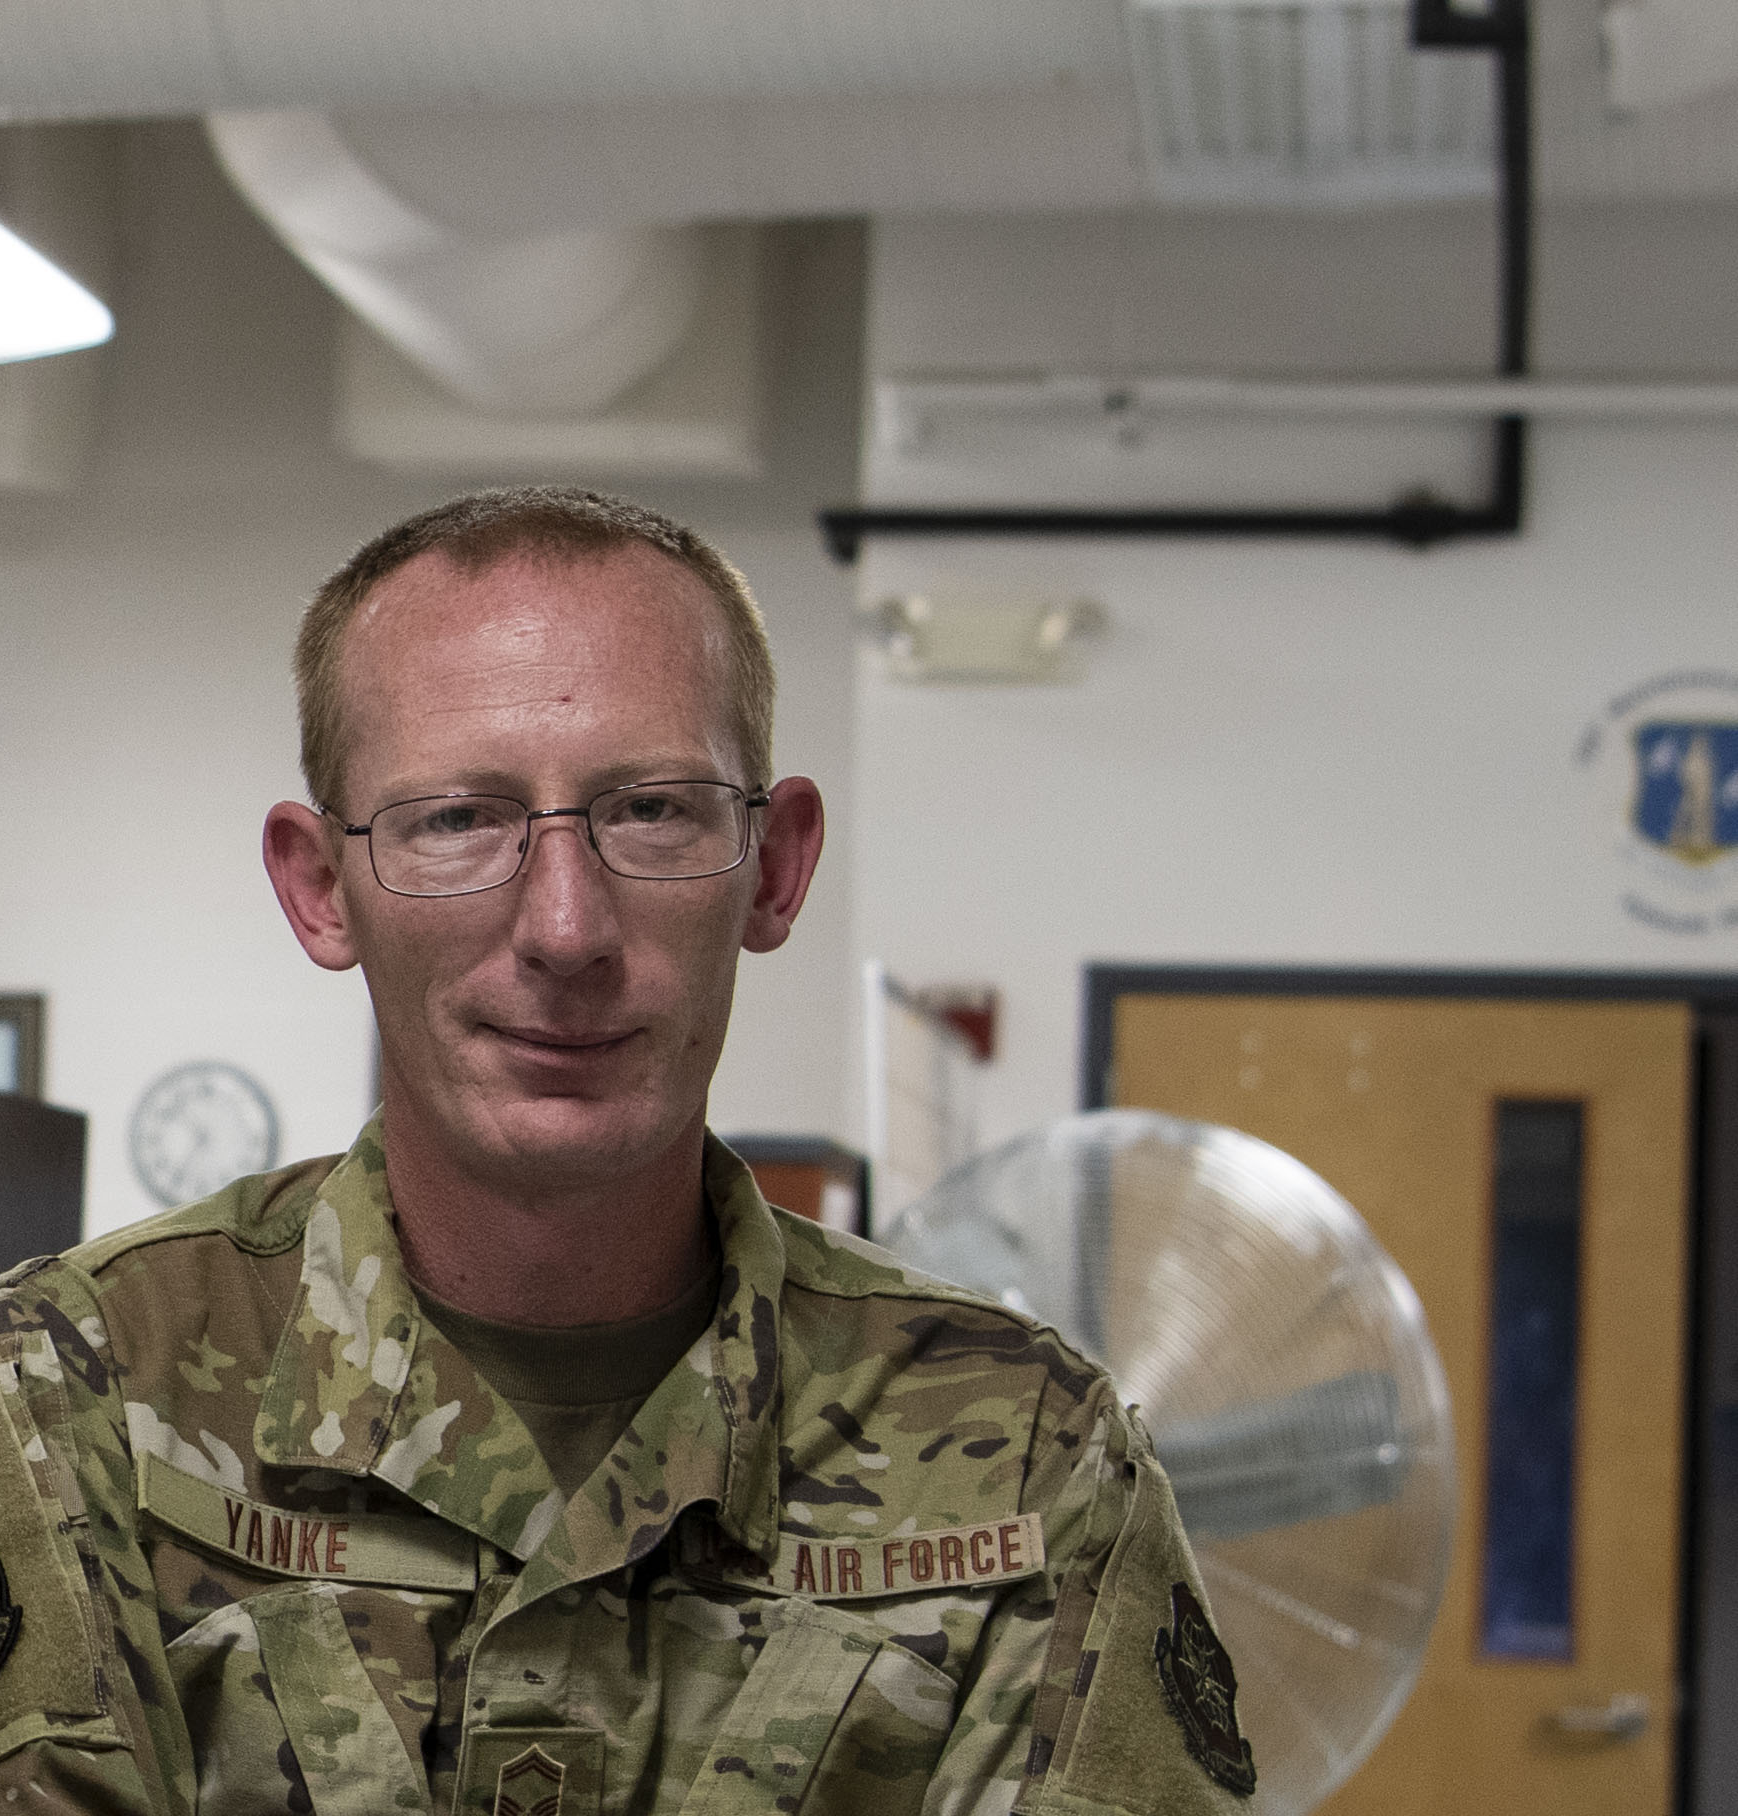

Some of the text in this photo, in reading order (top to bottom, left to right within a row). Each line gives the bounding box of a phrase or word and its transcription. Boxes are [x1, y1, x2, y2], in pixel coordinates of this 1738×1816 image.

[225, 1496, 349, 1573] YANKE
[793, 1543, 862, 1594] AIR
[882, 1524, 1023, 1589] FORCE
